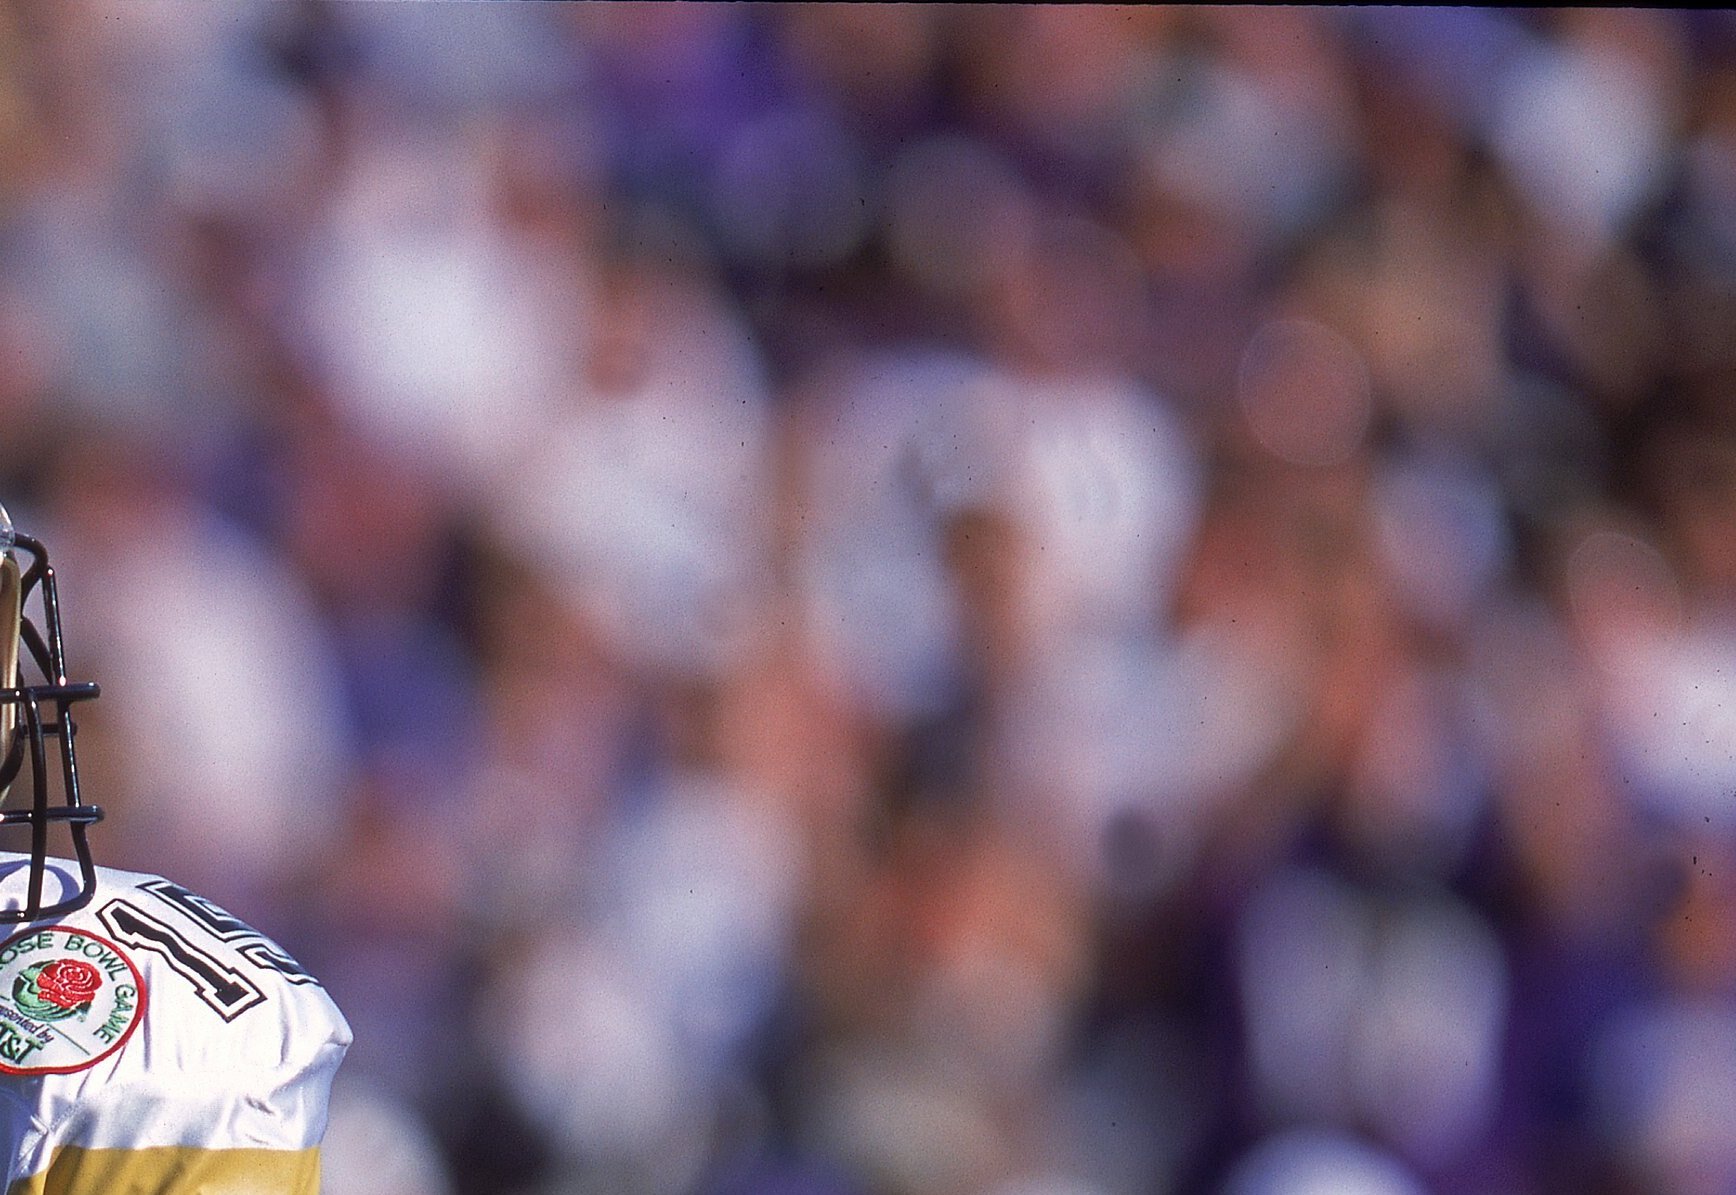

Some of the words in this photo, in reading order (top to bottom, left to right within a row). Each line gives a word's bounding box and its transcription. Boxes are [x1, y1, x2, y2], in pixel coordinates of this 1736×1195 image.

[64, 935, 128, 982] BOWL
[95, 880, 321, 1024] 15
[36, 1027, 54, 1044] by
[93, 984, 137, 1044] GAME
